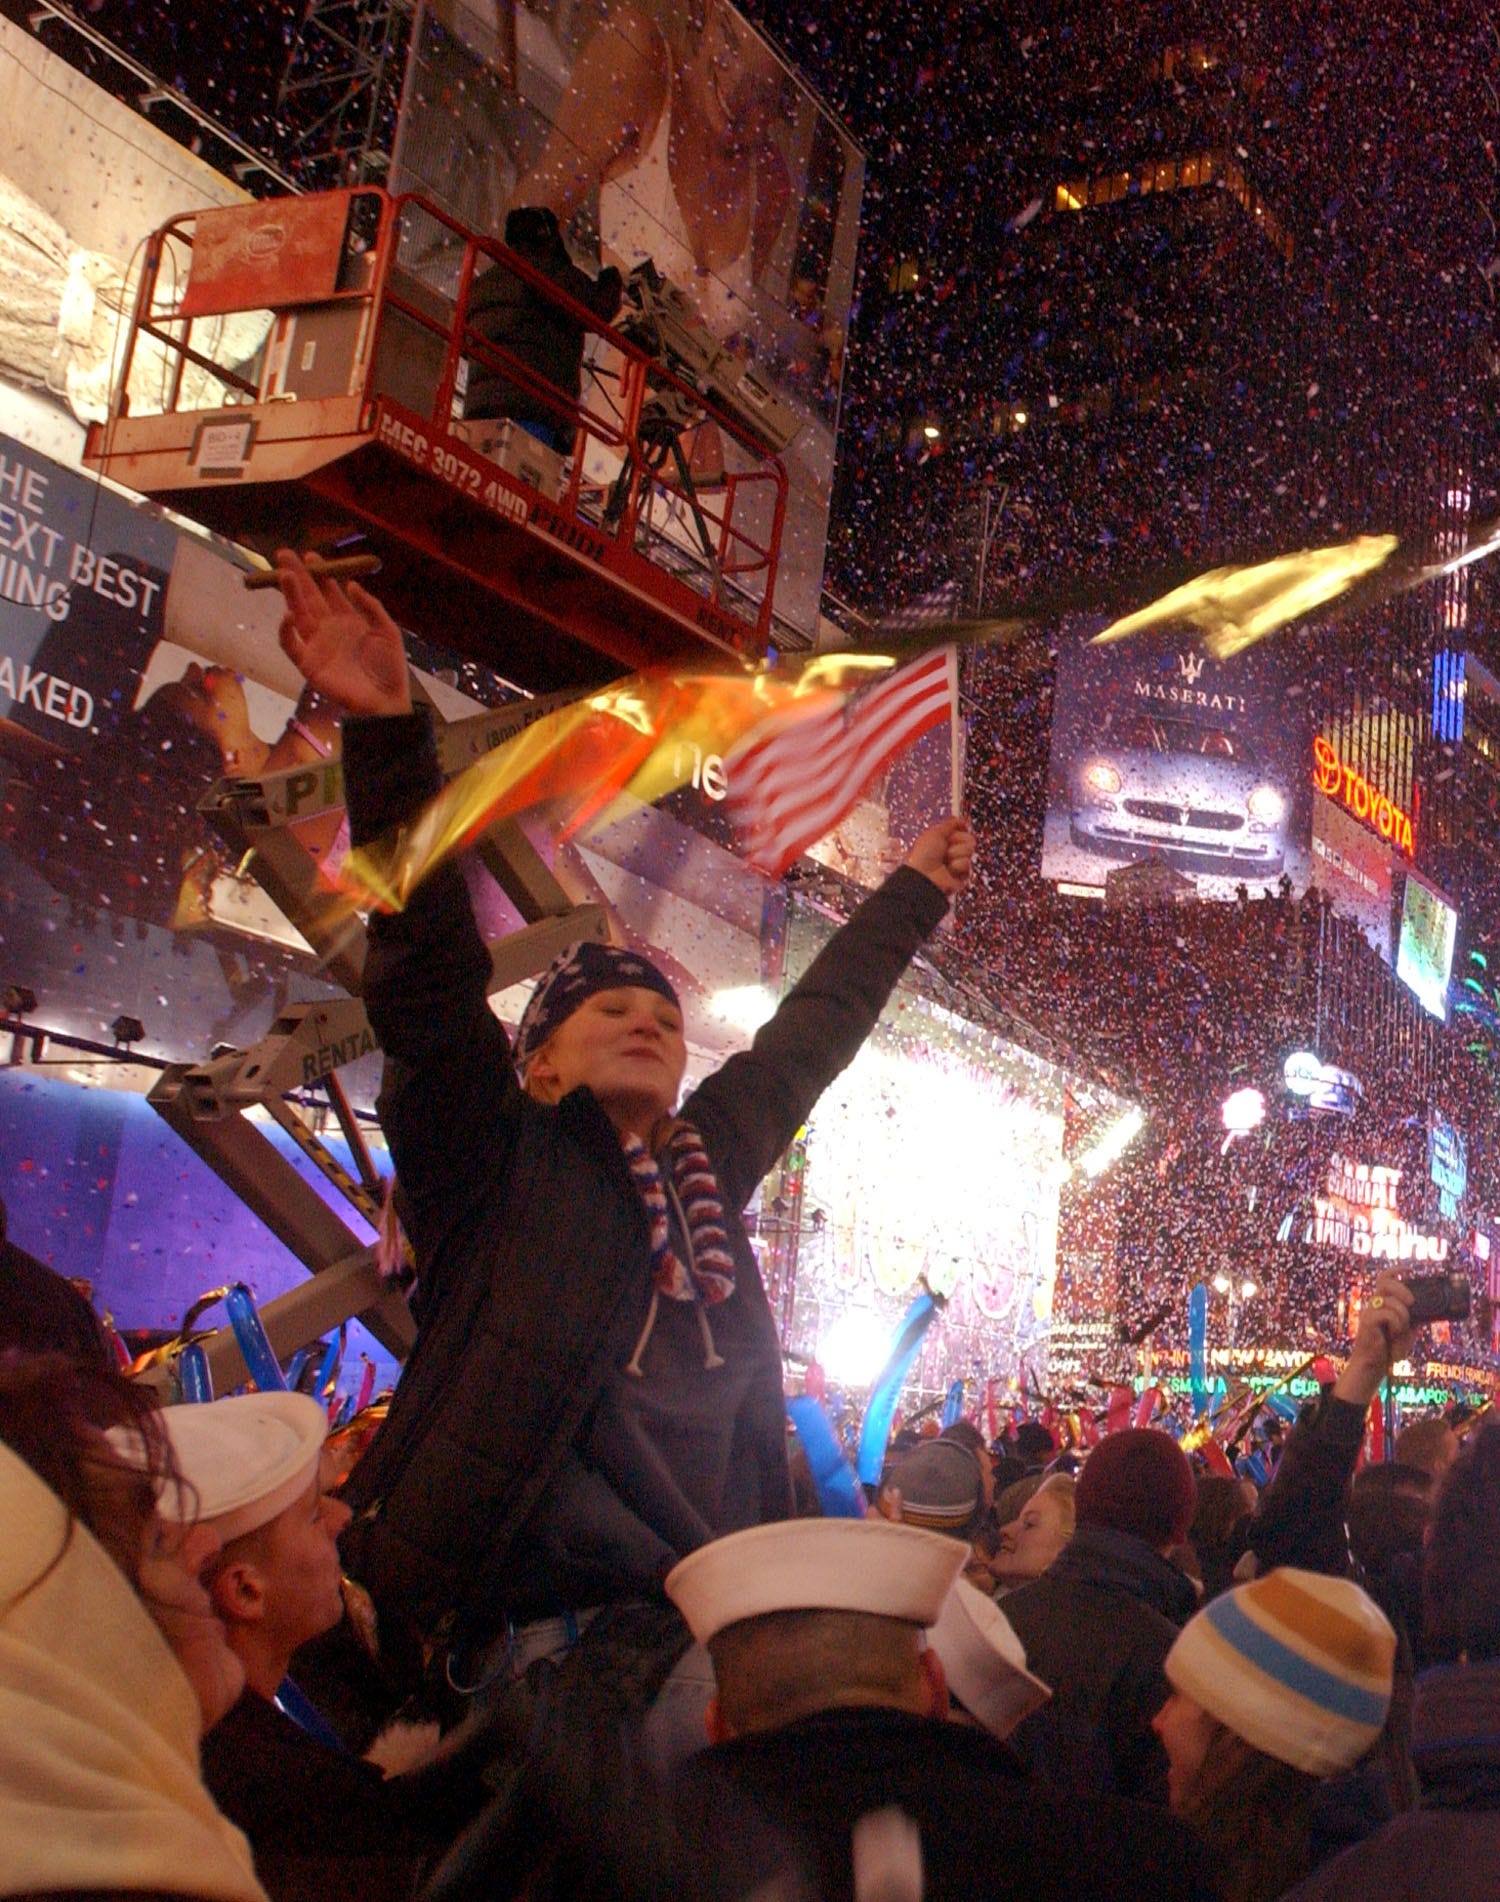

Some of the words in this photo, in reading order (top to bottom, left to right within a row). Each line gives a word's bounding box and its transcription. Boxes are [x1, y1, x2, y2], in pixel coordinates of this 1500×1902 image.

[0, 455, 49, 515] HE
[431, 446, 482, 499] 3072
[484, 481, 528, 526] 4WD
[0, 503, 64, 568] EXT
[69, 543, 160, 617] BEST
[0, 555, 71, 622] ING
[0, 655, 99, 735] AKED.
[1134, 680, 1246, 713] MASERATI
[674, 741, 728, 800] ne
[1342, 763, 1415, 857] TOYOTA
[302, 1028, 377, 1083] RENTA
